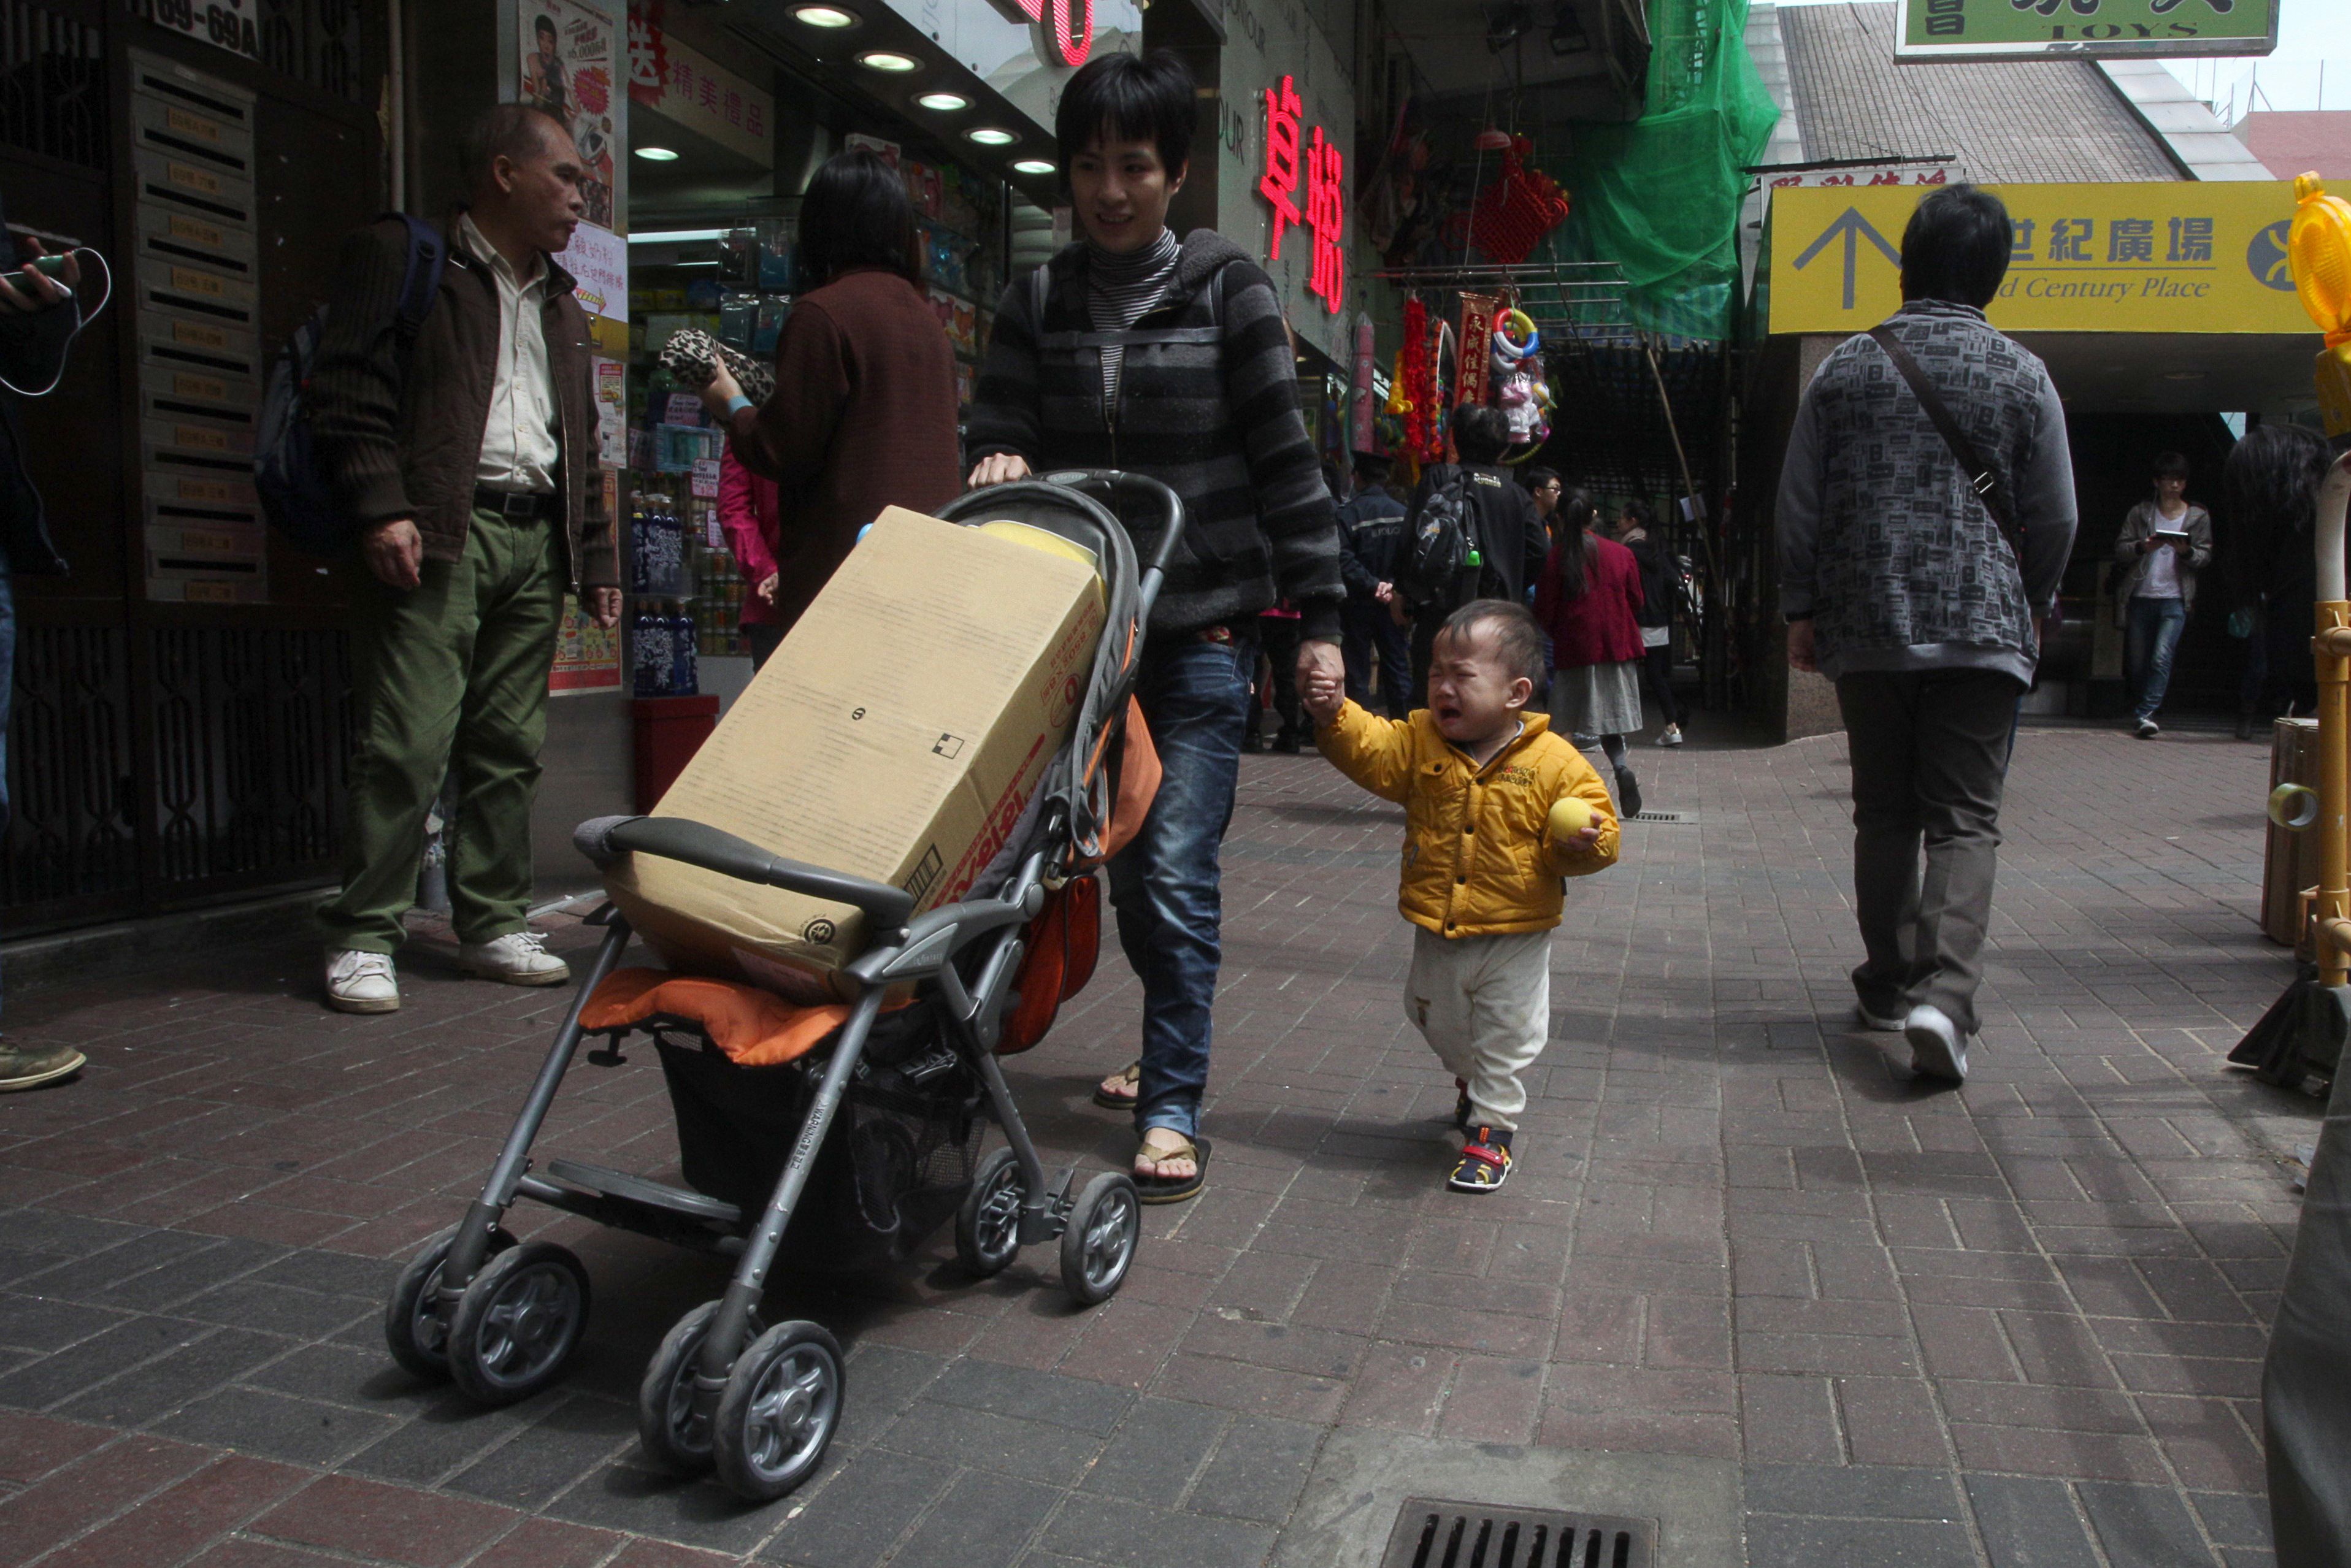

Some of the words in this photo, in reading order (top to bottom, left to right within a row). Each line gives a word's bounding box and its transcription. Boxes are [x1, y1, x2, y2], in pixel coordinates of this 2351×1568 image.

[157, 0, 259, 59] 69-69A
[2041, 21, 2198, 40] TOYS
[672, 59, 764, 137] 精美禮品
[2025, 276, 2136, 304] Century
[2139, 276, 2211, 298] Place
[802, 1107, 825, 1144] WARNING
